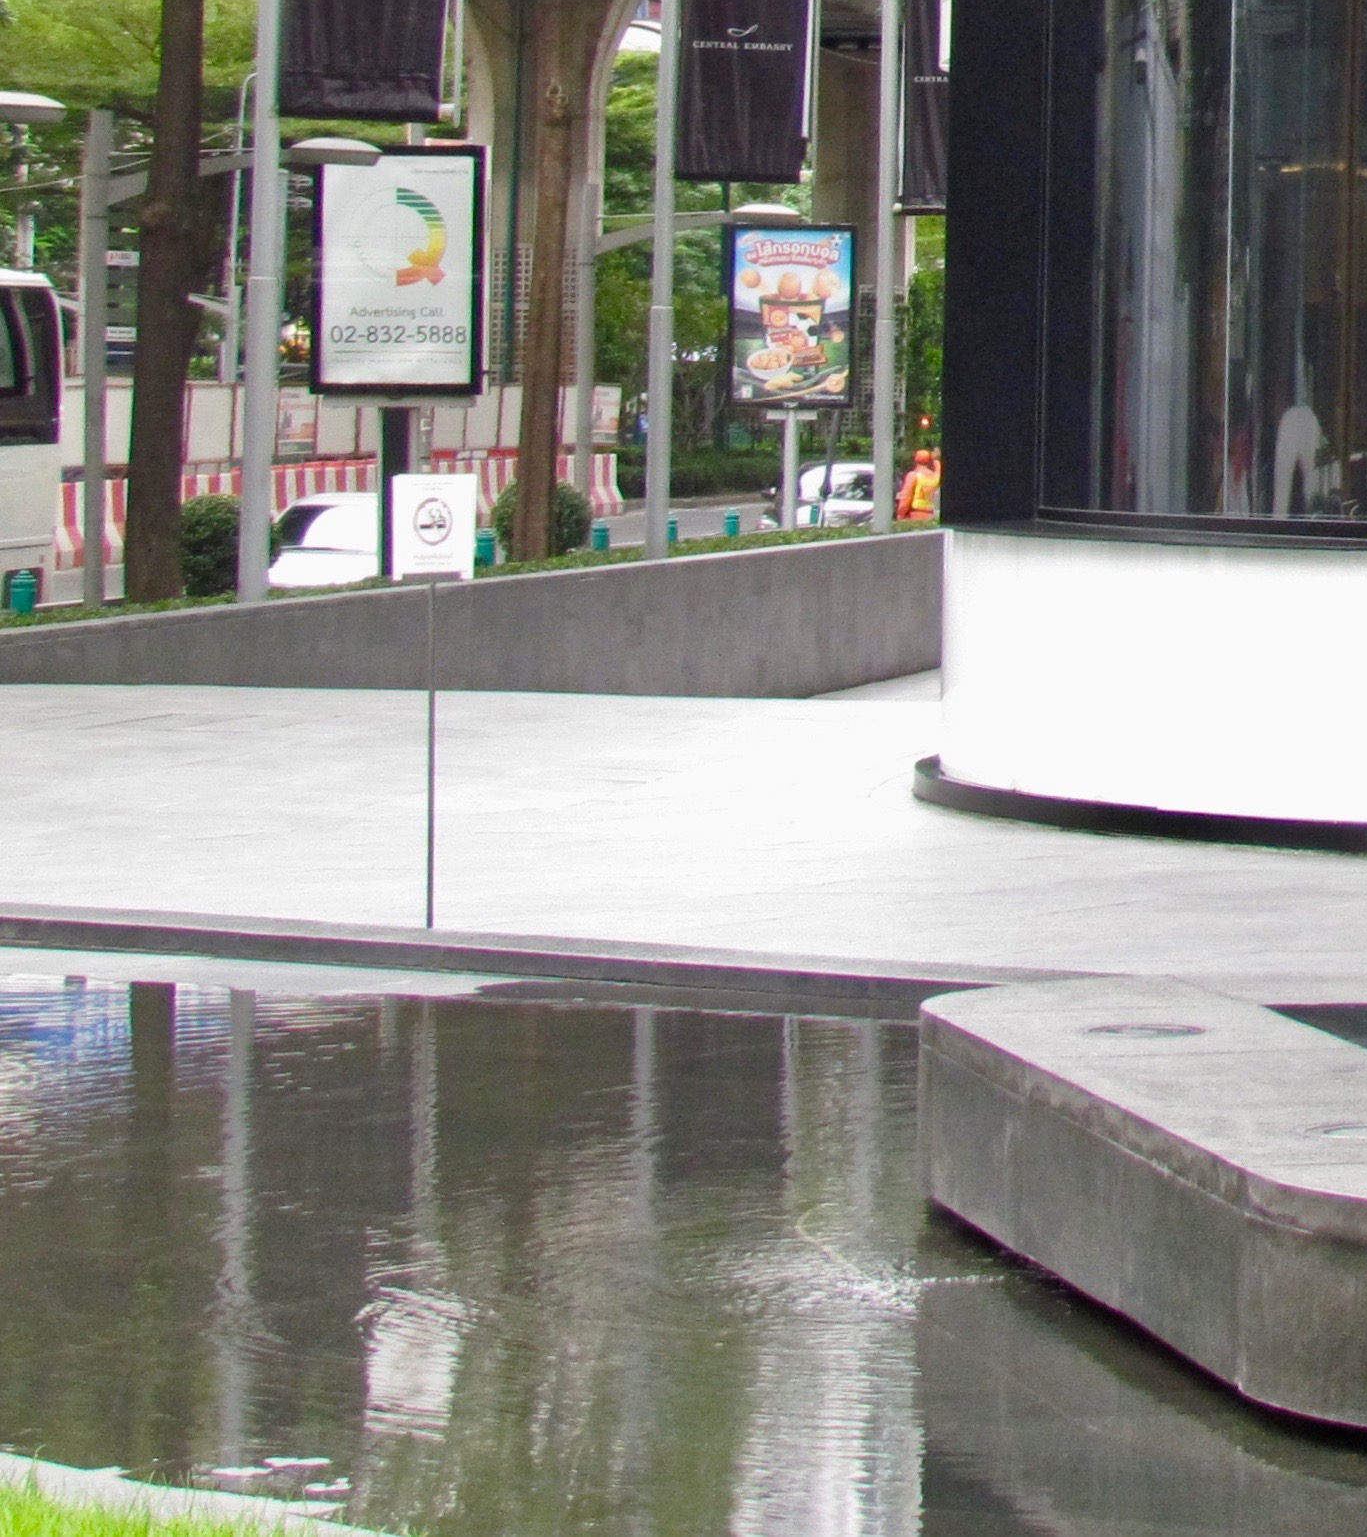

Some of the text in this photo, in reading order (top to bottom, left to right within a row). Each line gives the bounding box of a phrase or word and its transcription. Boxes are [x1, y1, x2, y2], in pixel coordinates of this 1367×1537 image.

[692, 40, 793, 51] CENTRAL EMBASSY
[914, 75, 949, 83] CENTRA
[350, 306, 443, 319] Advertising Call
[330, 325, 467, 344] 02-832-5888
